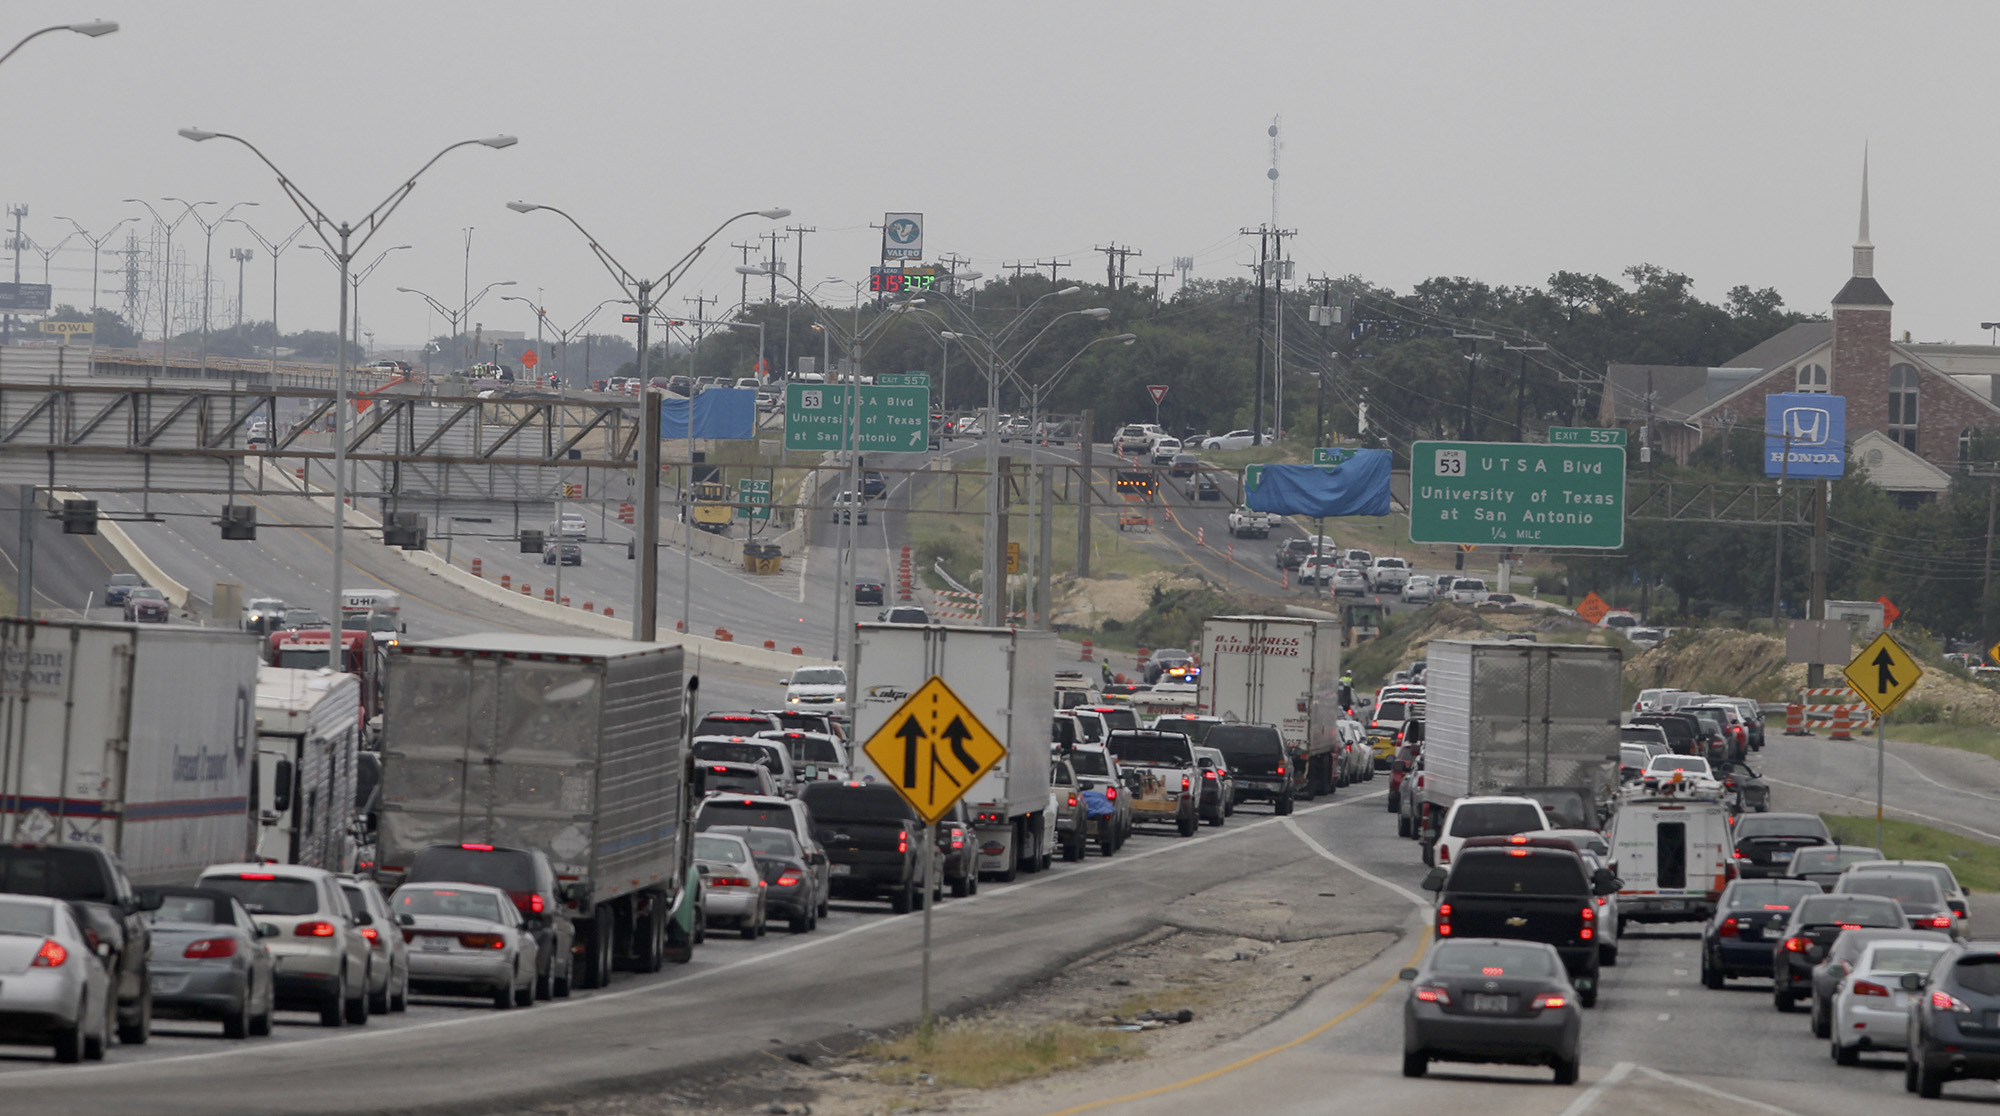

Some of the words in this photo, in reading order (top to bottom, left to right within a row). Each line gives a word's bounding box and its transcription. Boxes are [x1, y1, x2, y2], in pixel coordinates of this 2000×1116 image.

[887, 249, 920, 257] VALERO
[47, 323, 89, 332] BOWL
[904, 376, 927, 385] 557
[804, 396, 820, 408] 53
[887, 397, 914, 406] Blvd
[792, 413, 856, 426] Universiy
[866, 415, 877, 424] of
[887, 415, 922, 425] Texas
[794, 431, 807, 441] at
[817, 432, 839, 442] San
[1555, 431, 1579, 441] EXIT
[1589, 431, 1620, 443] 557
[1770, 452, 1841, 463] HONDA
[1440, 459, 1461, 473] 53
[1563, 460, 1602, 474] Blvd
[748, 482, 766, 490] 57
[1421, 486, 1515, 503] University
[1531, 489, 1547, 503] of
[1563, 490, 1615, 505] Texas
[1440, 508, 1459, 520] at
[1474, 508, 1507, 521] San
[1522, 509, 1593, 524] Antonio
[1516, 530, 1541, 539] MILE
[1215, 644, 1299, 656] ENTERPRISES
